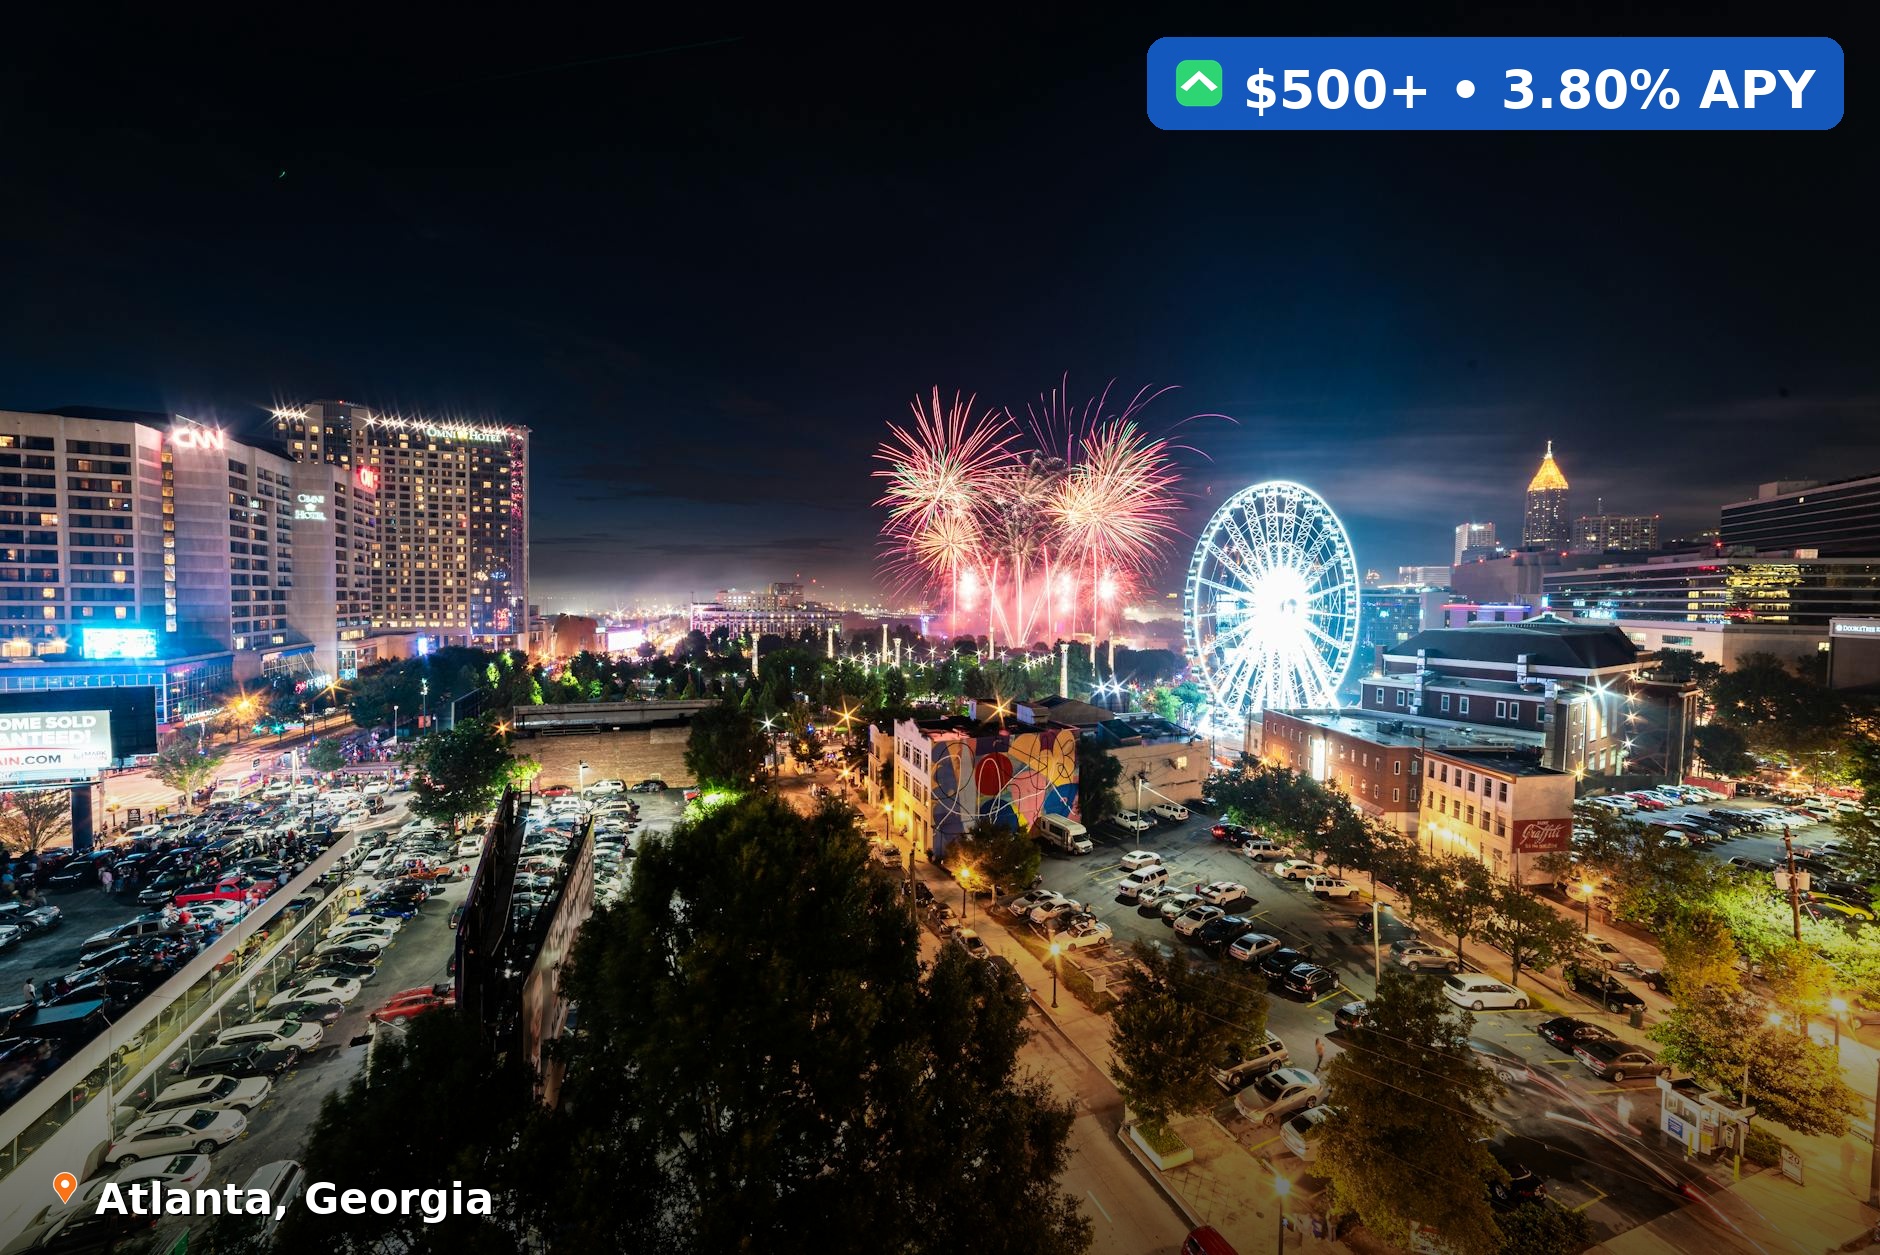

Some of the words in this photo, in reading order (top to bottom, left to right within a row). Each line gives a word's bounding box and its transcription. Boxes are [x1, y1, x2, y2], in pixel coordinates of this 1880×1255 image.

[172, 428, 224, 449] CNN
[426, 427, 457, 439] OMNI
[469, 431, 501, 442] HOTEL
[297, 493, 325, 504] OMNI
[45, 715, 97, 729] SOLD
[1520, 823, 1567, 846] Graffiti
